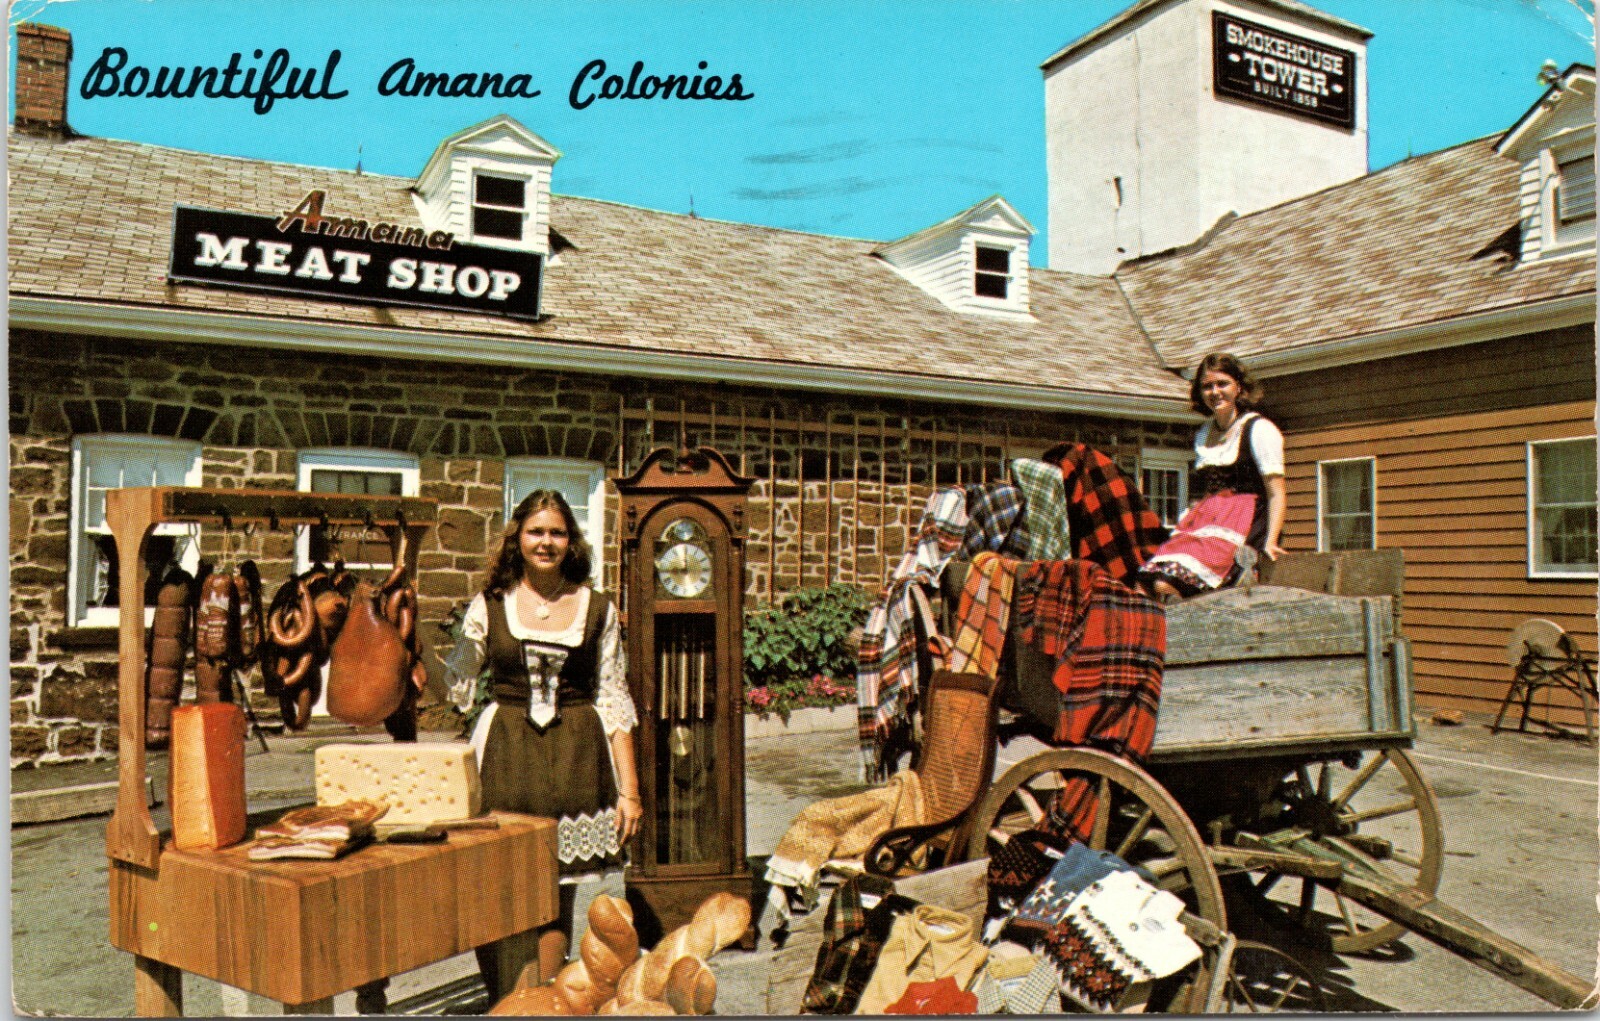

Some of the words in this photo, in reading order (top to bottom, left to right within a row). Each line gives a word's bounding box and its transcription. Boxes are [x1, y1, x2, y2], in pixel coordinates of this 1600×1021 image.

[1226, 23, 1343, 75] SMOKEHOUSE
[1243, 51, 1329, 96] TOWER
[1254, 80, 1290, 99] BUILT
[276, 189, 455, 250] Amana
[195, 233, 371, 283] MEAT
[387, 257, 521, 300] SHOP
